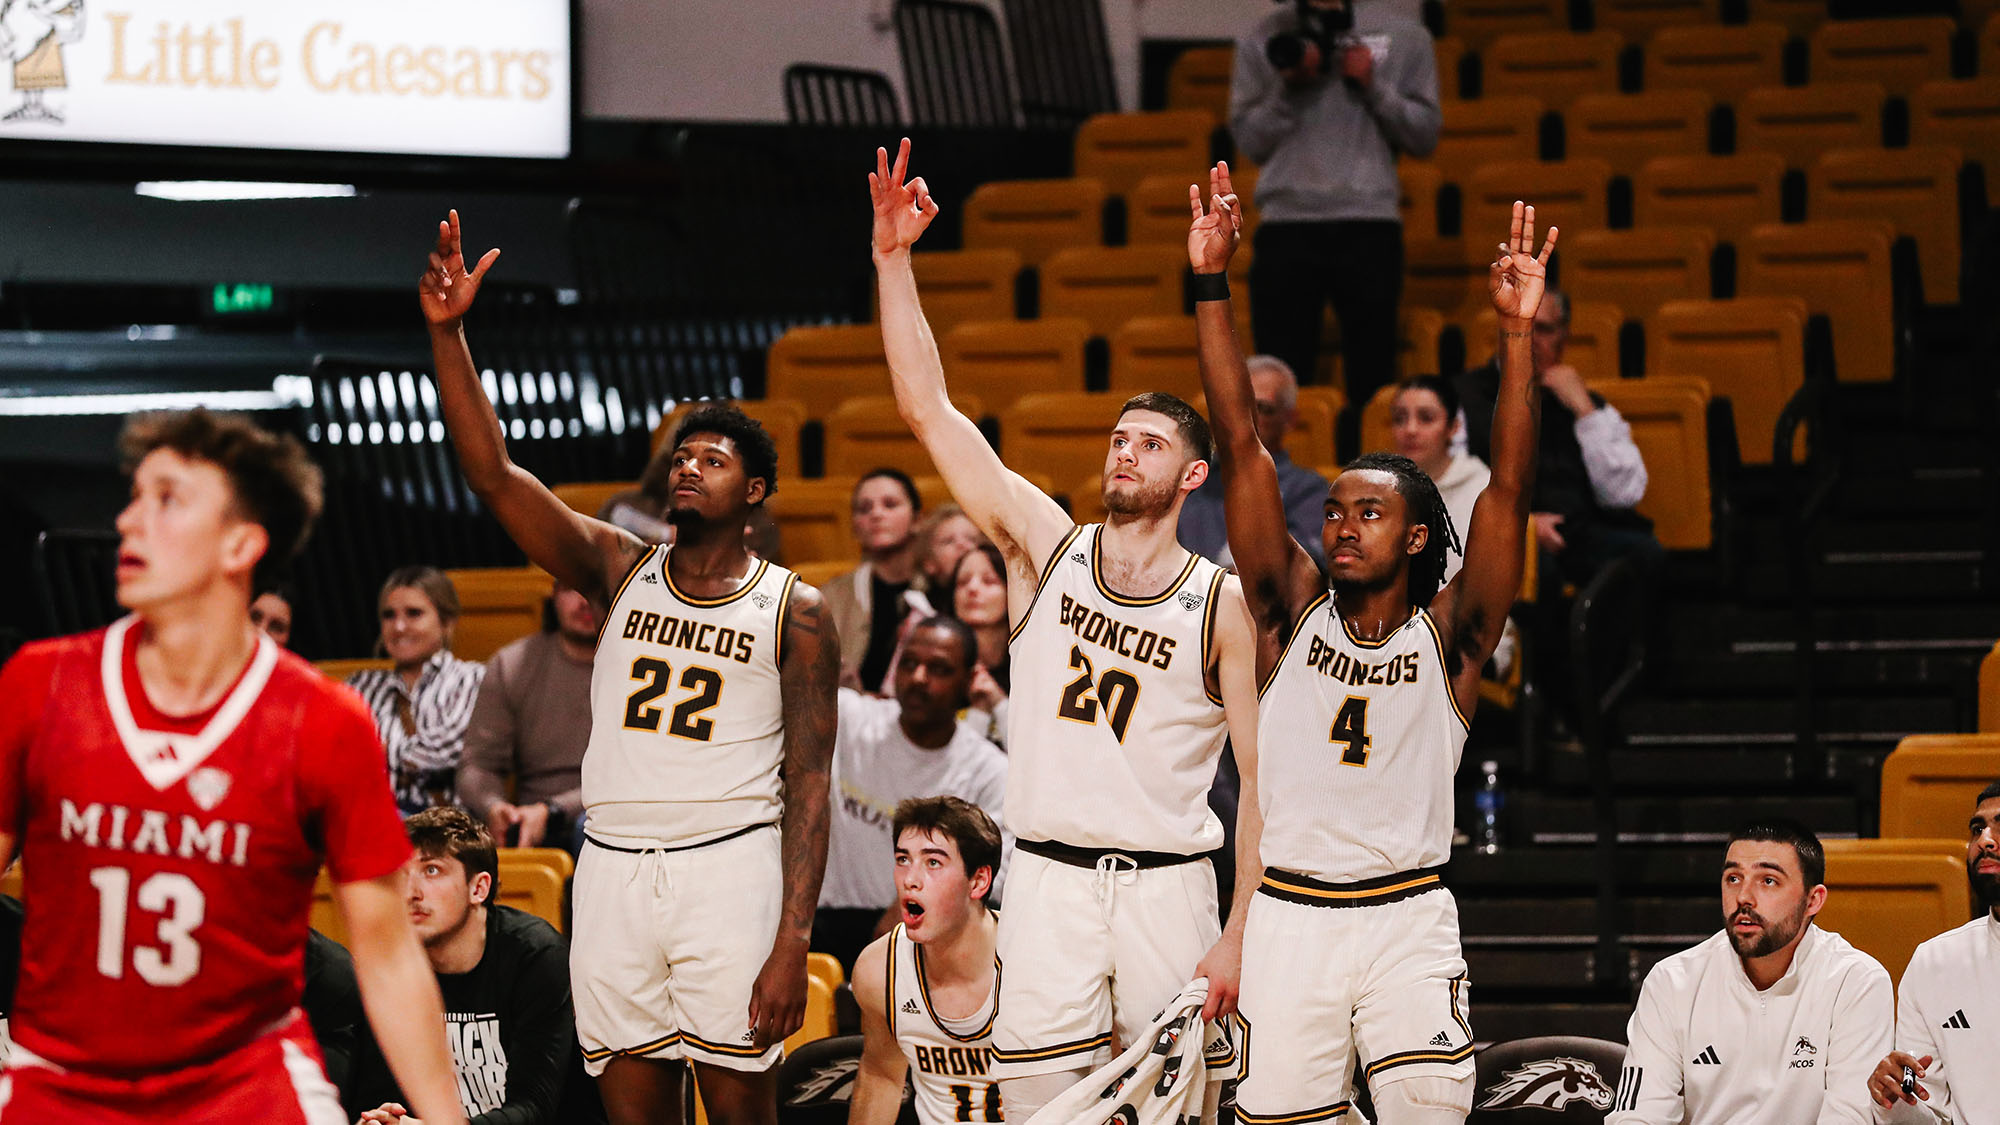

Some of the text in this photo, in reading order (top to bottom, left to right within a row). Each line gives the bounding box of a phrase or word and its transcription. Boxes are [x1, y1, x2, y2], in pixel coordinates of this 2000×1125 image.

[103, 11, 551, 101] Little Caesars
[622, 609, 755, 664] BRONCOS
[1059, 592, 1177, 671] BRONCOS
[1306, 633, 1419, 686] BRONCOS
[621, 654, 725, 742] 22
[1056, 642, 1142, 745] 20
[1328, 694, 1372, 768] 4
[60, 799, 251, 866] MIAMI
[89, 865, 206, 987] 13
[445, 1020, 507, 1068] ACK
[914, 1044, 993, 1076] BRON
